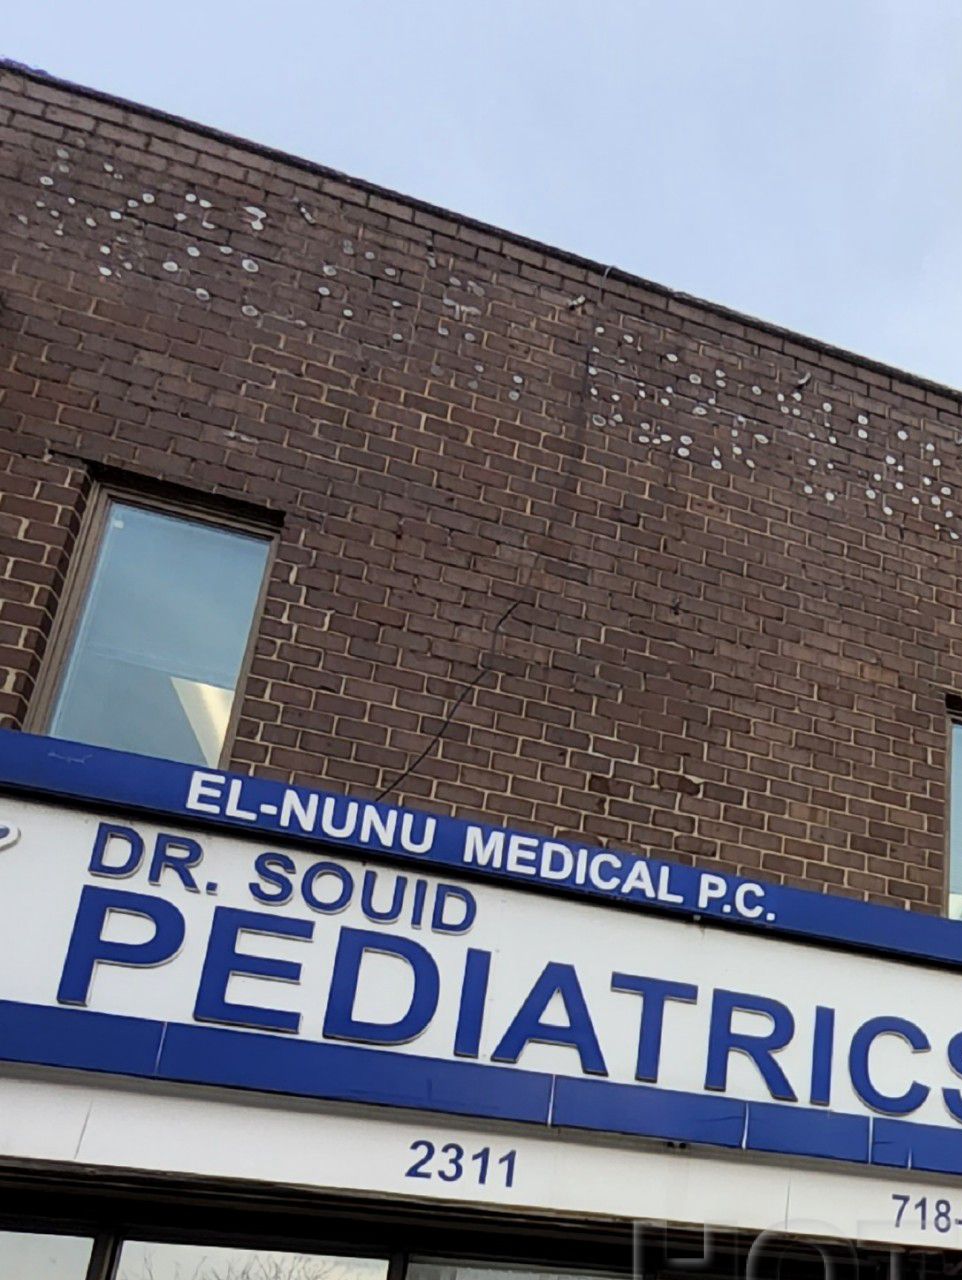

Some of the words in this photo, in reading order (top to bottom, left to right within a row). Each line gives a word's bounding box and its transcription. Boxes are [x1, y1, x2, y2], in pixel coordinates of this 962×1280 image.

[88, 822, 219, 895] DR.
[248, 852, 478, 936] SOUID
[186, 771, 437, 854] EL-NUNU
[463, 829, 685, 905] MEDICAL
[698, 873, 777, 921] P.C.
[405, 1139, 518, 1189] 2311
